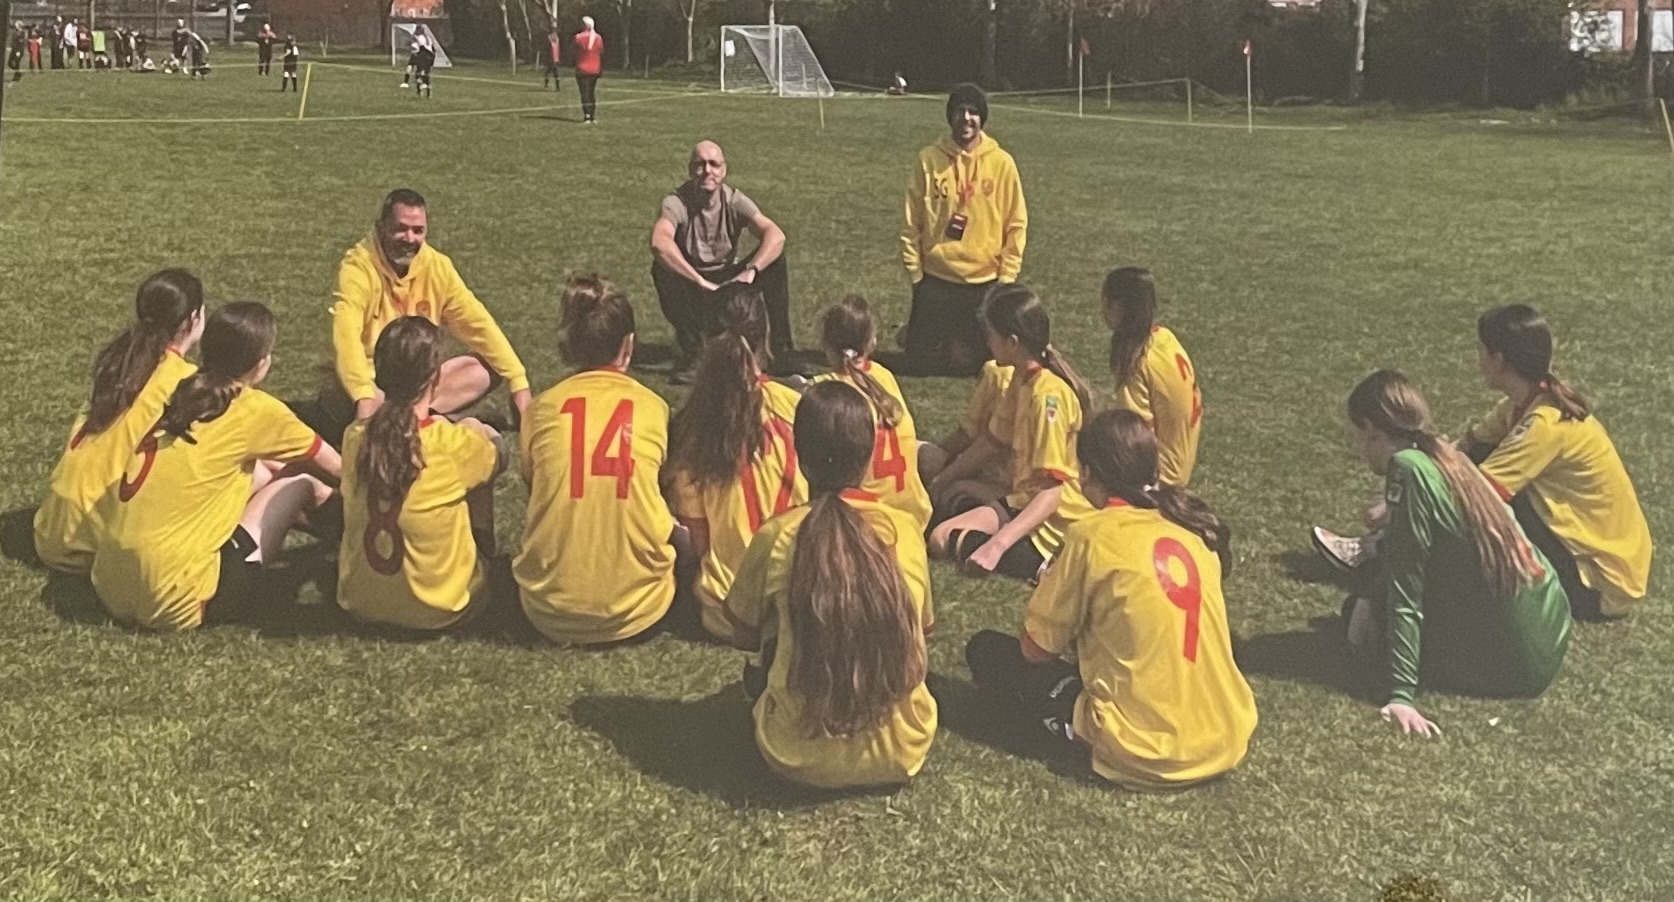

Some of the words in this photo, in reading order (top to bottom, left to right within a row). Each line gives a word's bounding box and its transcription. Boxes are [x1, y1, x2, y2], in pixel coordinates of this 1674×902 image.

[560, 396, 635, 500] 14
[872, 424, 907, 493] 4
[362, 484, 404, 577] 8
[1152, 536, 1202, 664] 9
